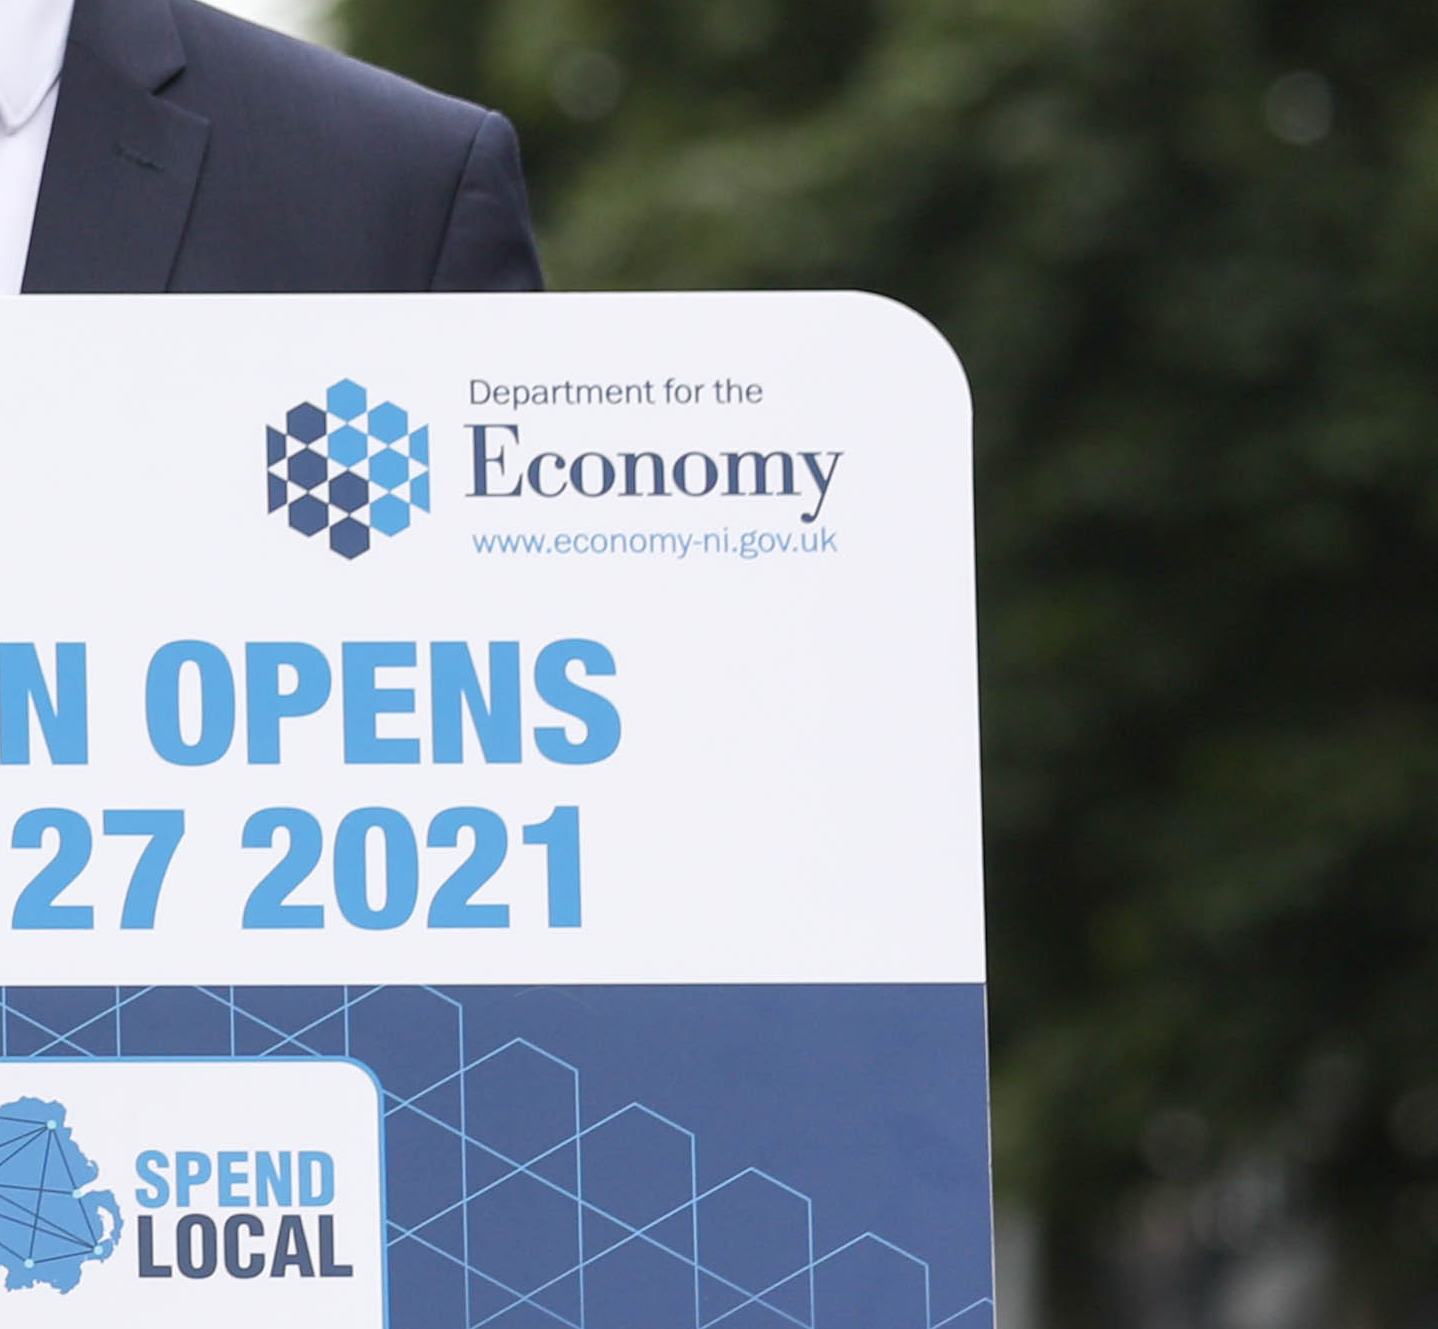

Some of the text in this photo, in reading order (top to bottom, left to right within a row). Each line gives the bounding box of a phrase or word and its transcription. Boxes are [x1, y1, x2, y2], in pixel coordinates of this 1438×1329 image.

[469, 377, 763, 411] Department for the
[464, 423, 844, 524] Economy
[472, 526, 837, 559] www.economy-ni.gov.uk
[144, 638, 622, 767] OPENS
[11, 807, 186, 931] 27
[241, 805, 582, 931] 2021
[135, 1149, 335, 1209] SPEND
[137, 1213, 354, 1280] LOCAL
